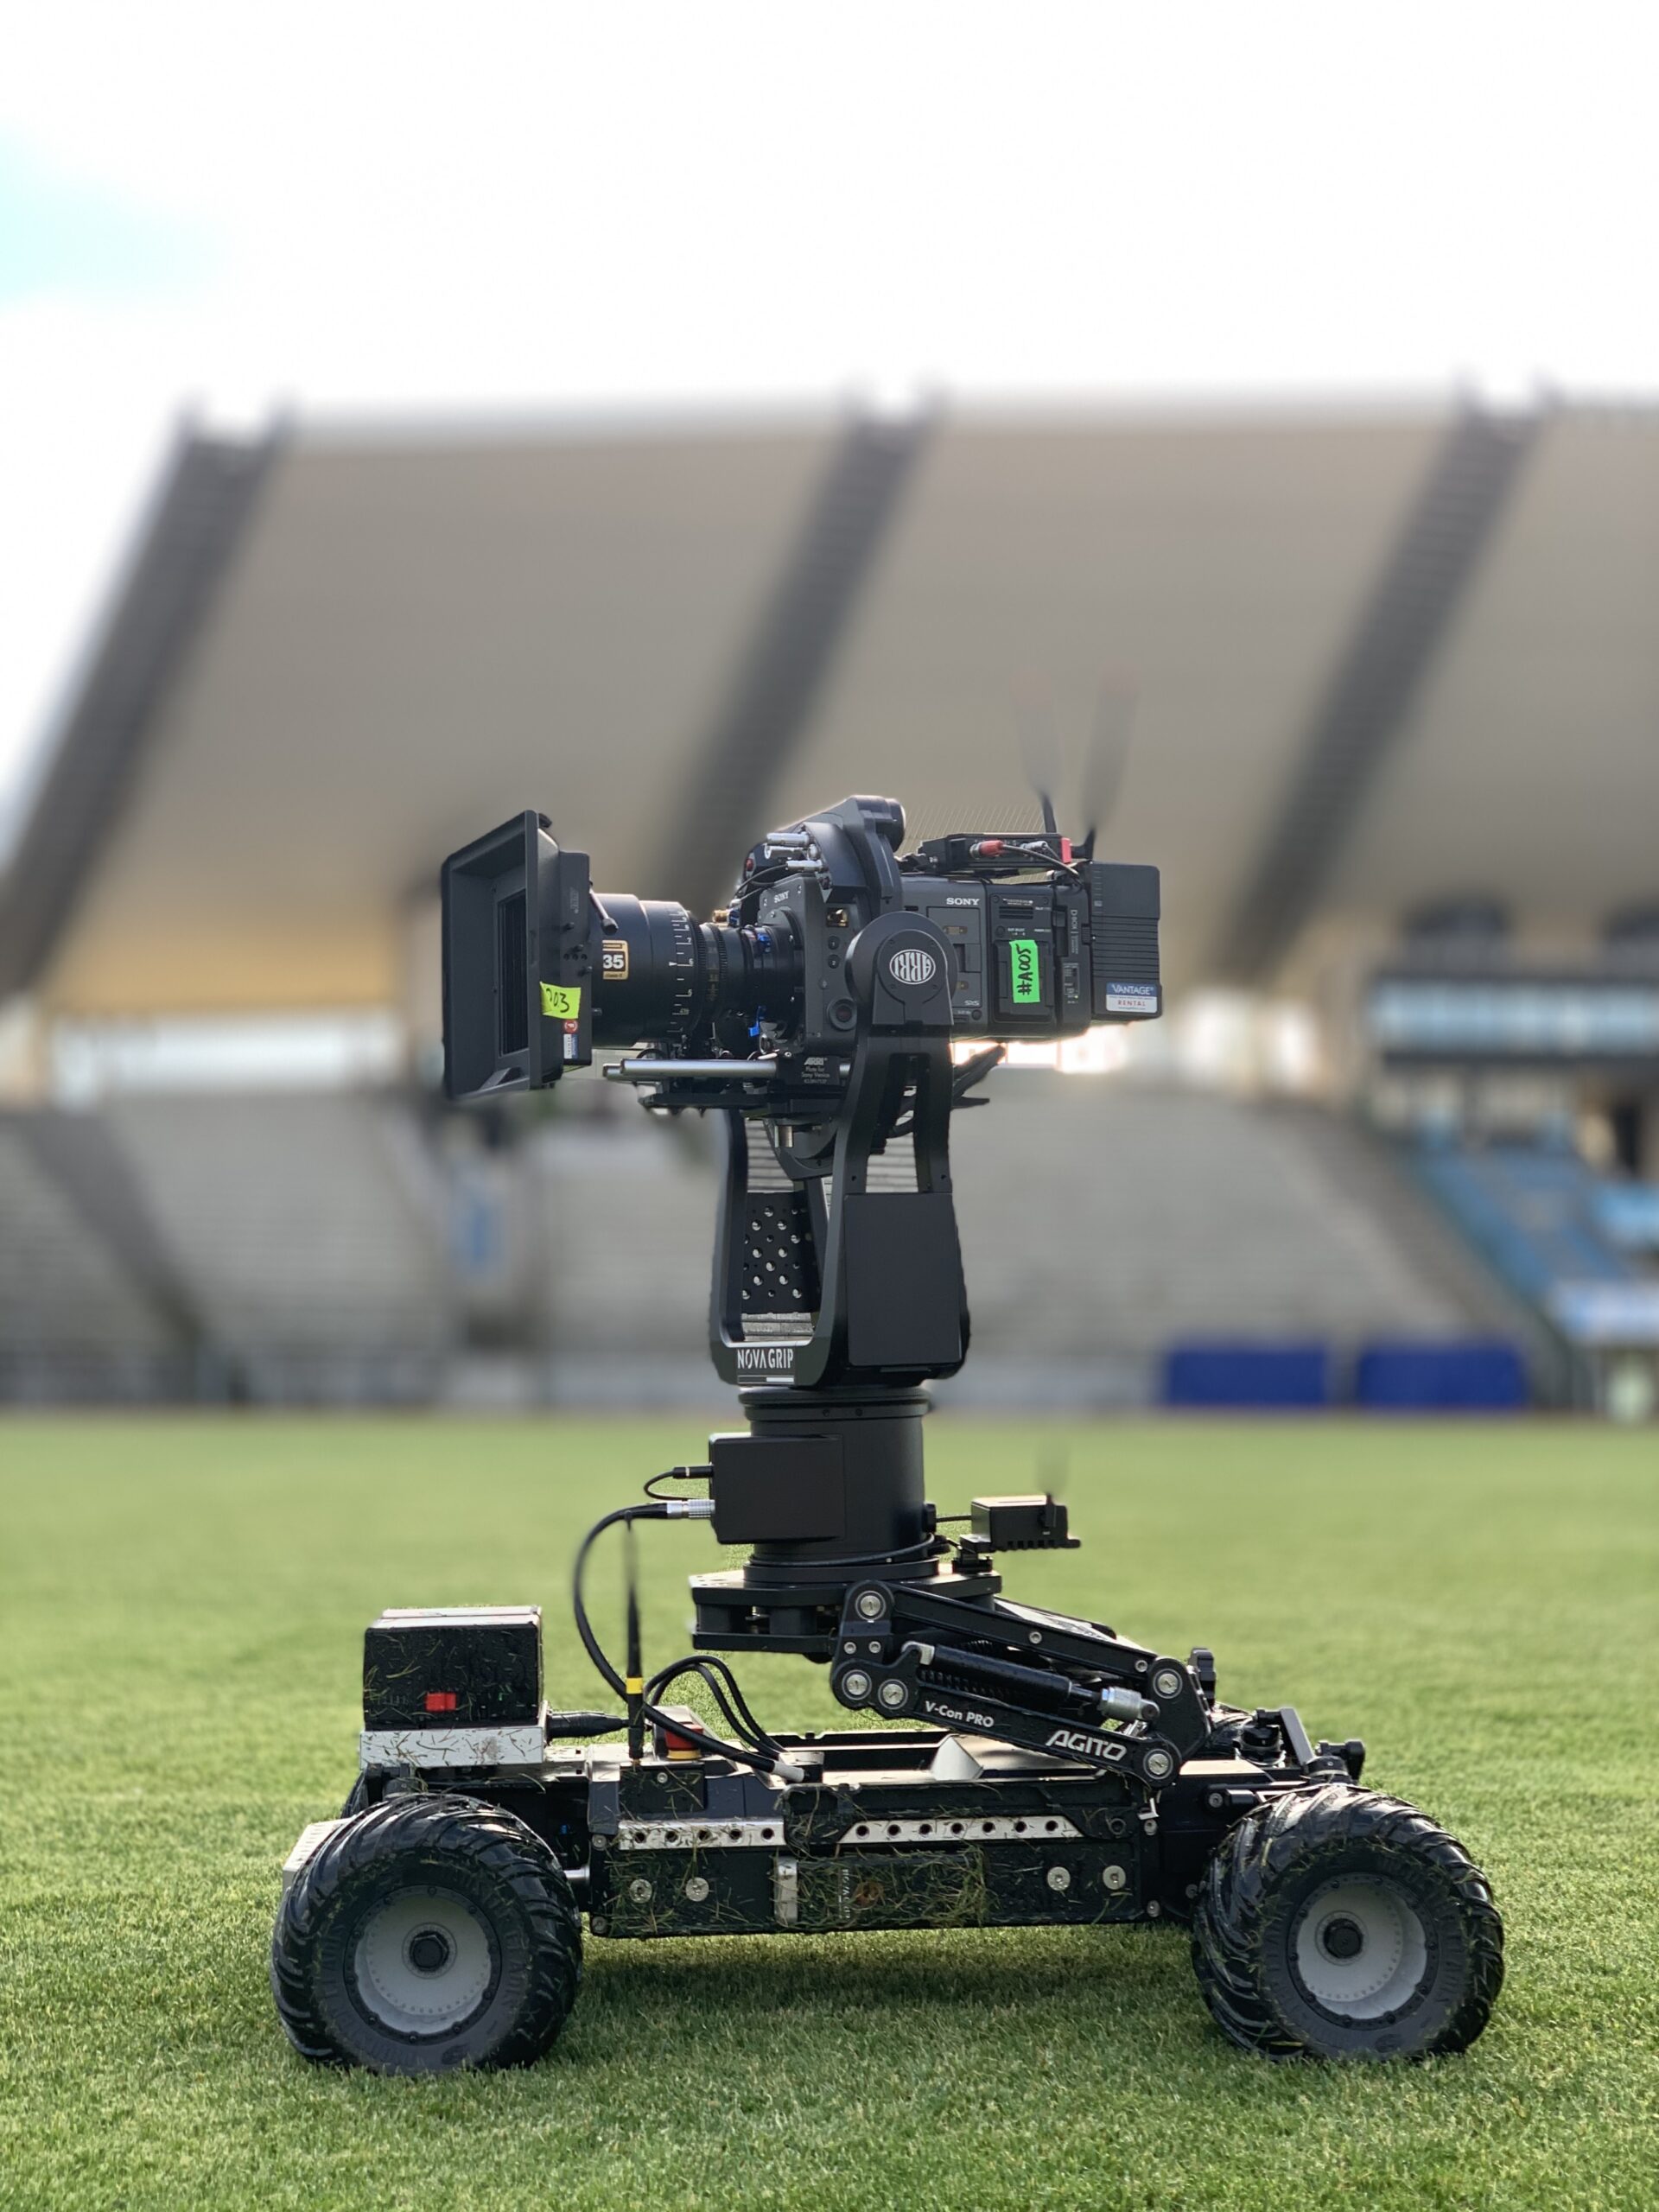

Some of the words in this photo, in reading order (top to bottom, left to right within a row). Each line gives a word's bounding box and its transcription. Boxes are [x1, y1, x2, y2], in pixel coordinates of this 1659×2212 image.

[774, 890, 790, 904] SONY
[946, 897, 980, 906] SONY
[603, 954, 624, 969] 35
[894, 952, 931, 982] ARRI
[1014, 944, 1033, 995] #A005
[925, 1700, 963, 1721] V-Con
[966, 1712, 995, 1728] PRO
[1046, 1730, 1128, 1762] AGITO
